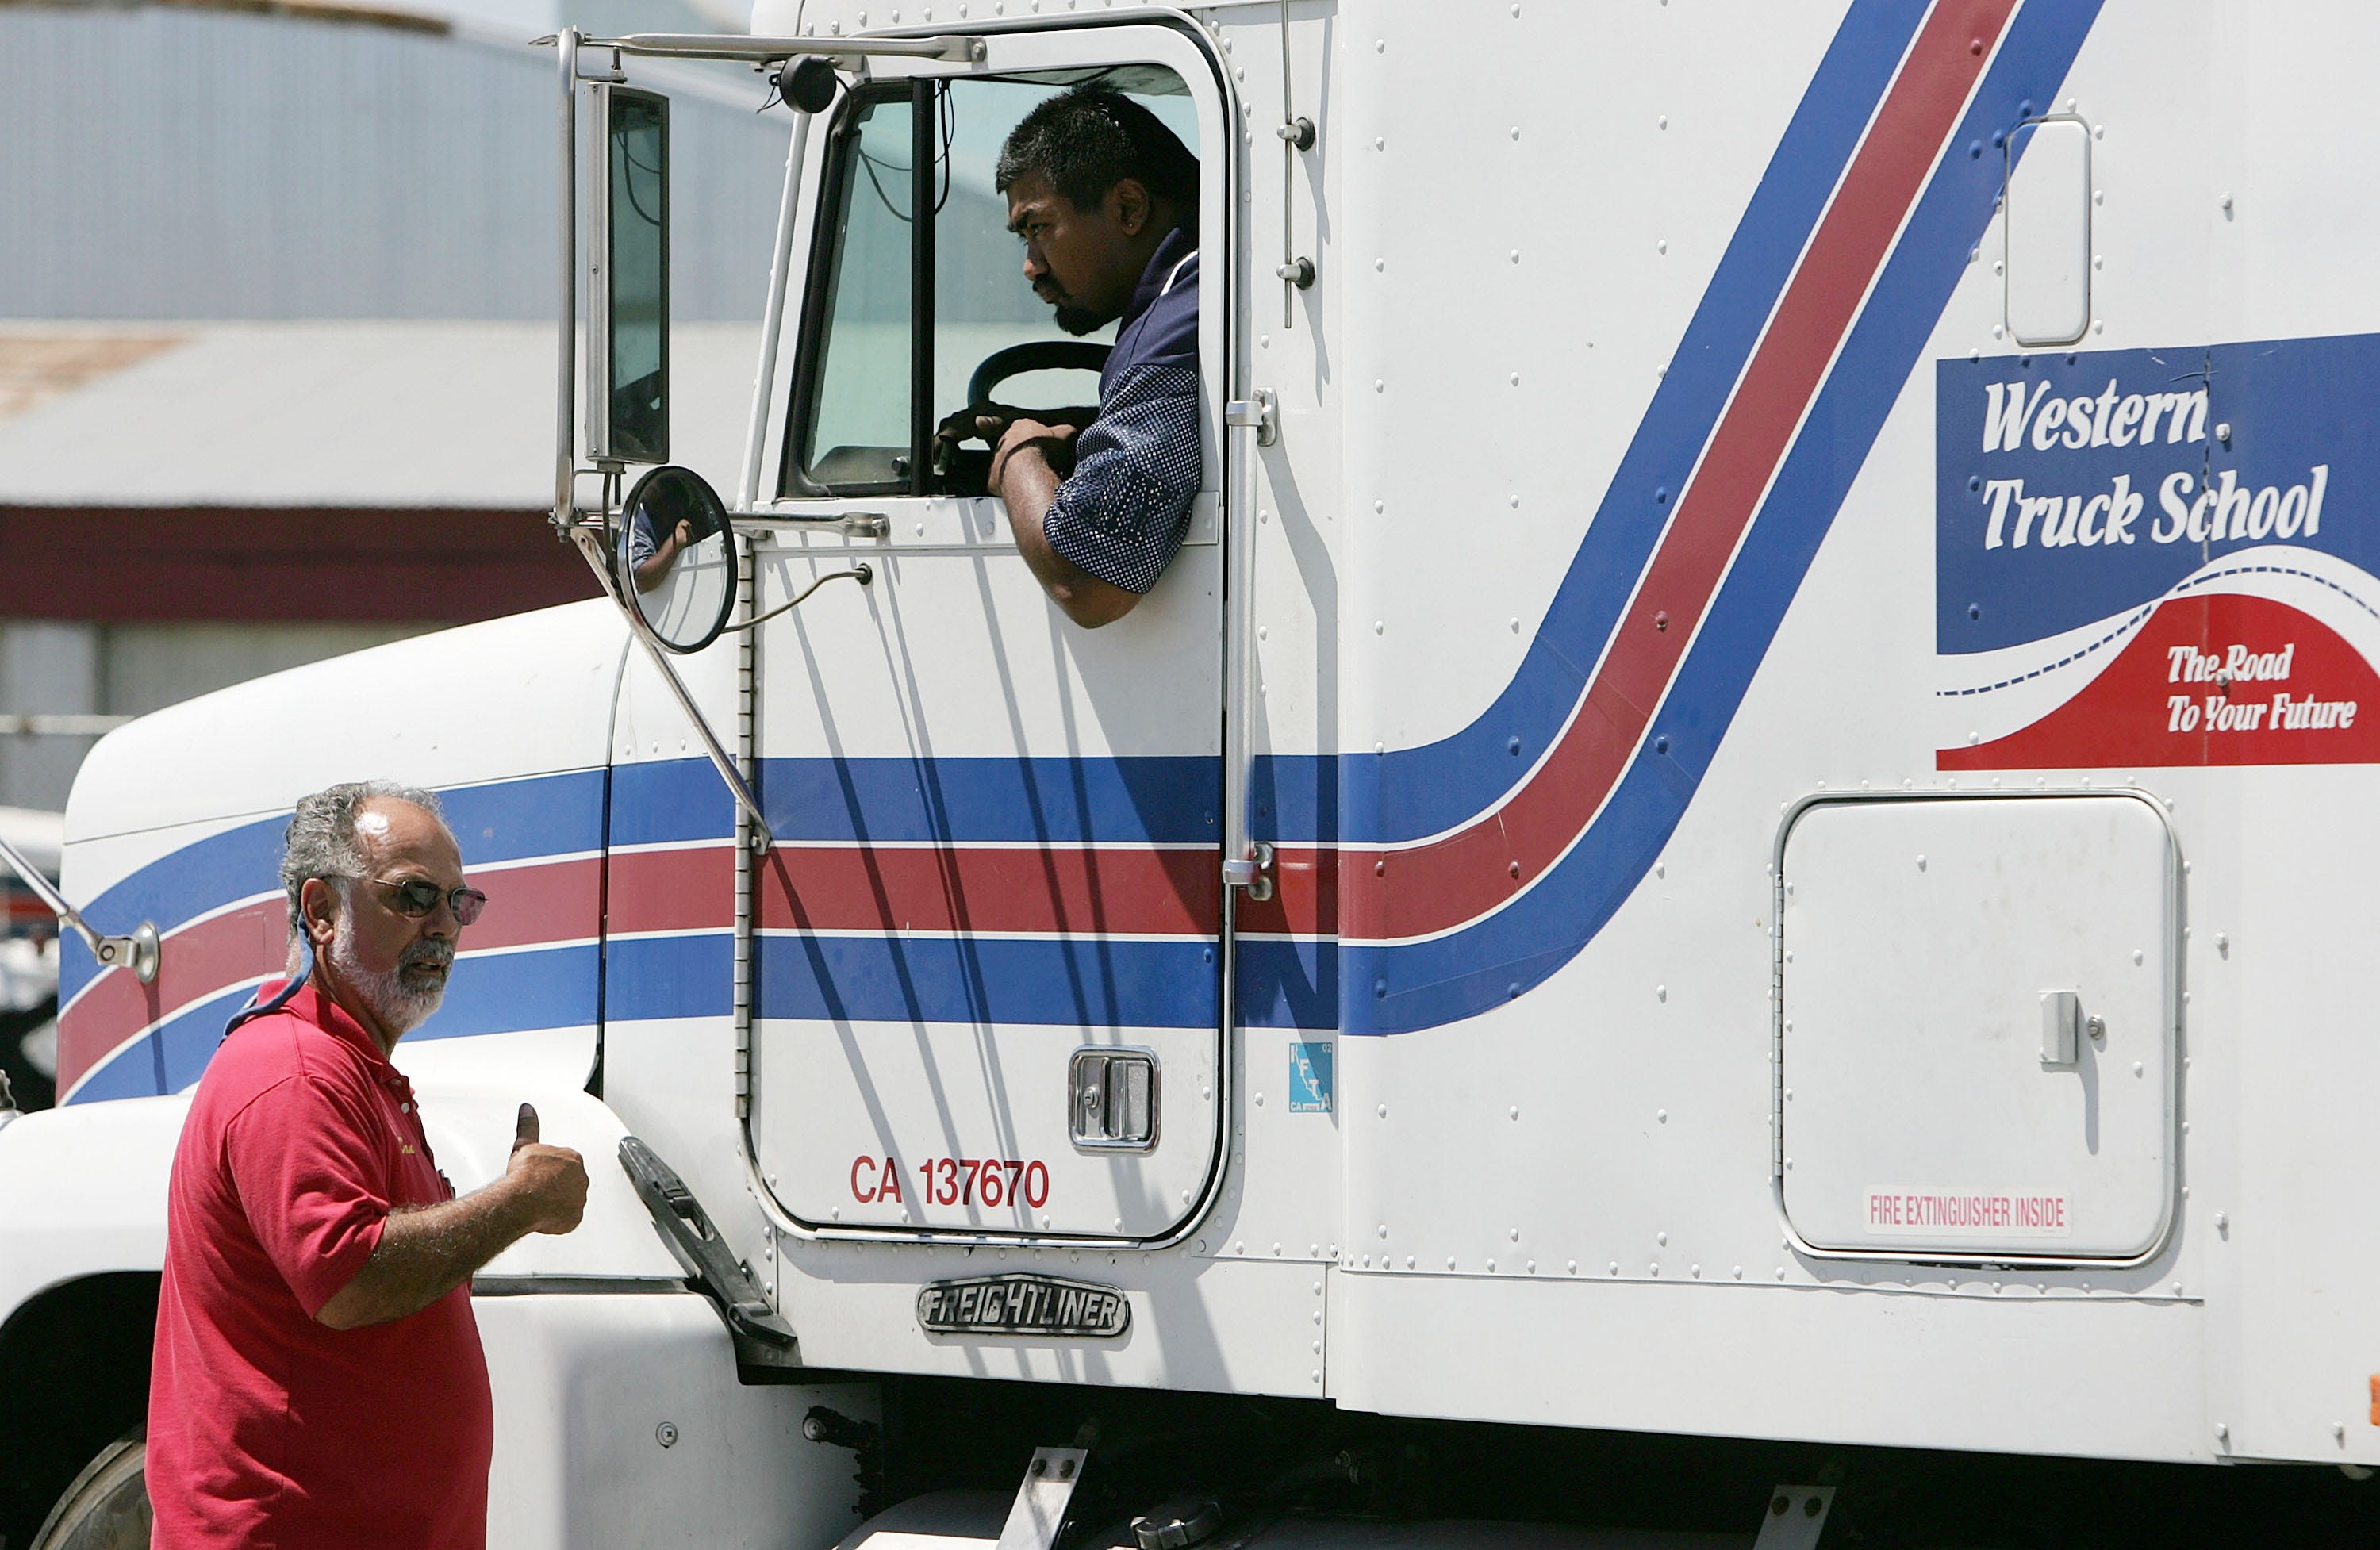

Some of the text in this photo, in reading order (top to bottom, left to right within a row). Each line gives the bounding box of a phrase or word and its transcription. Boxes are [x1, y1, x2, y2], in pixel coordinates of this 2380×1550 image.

[1983, 378, 2209, 453] Western
[1983, 464, 2329, 551] Truck School
[2167, 643, 2295, 683] The Road
[2167, 693, 2358, 733] To Your Future
[850, 1155, 1050, 1208] CA 137670
[1870, 1195, 2065, 1228] FIRE EXTINGUISHER INSIDE
[924, 1283, 1119, 1328] FREIGHTLINER
